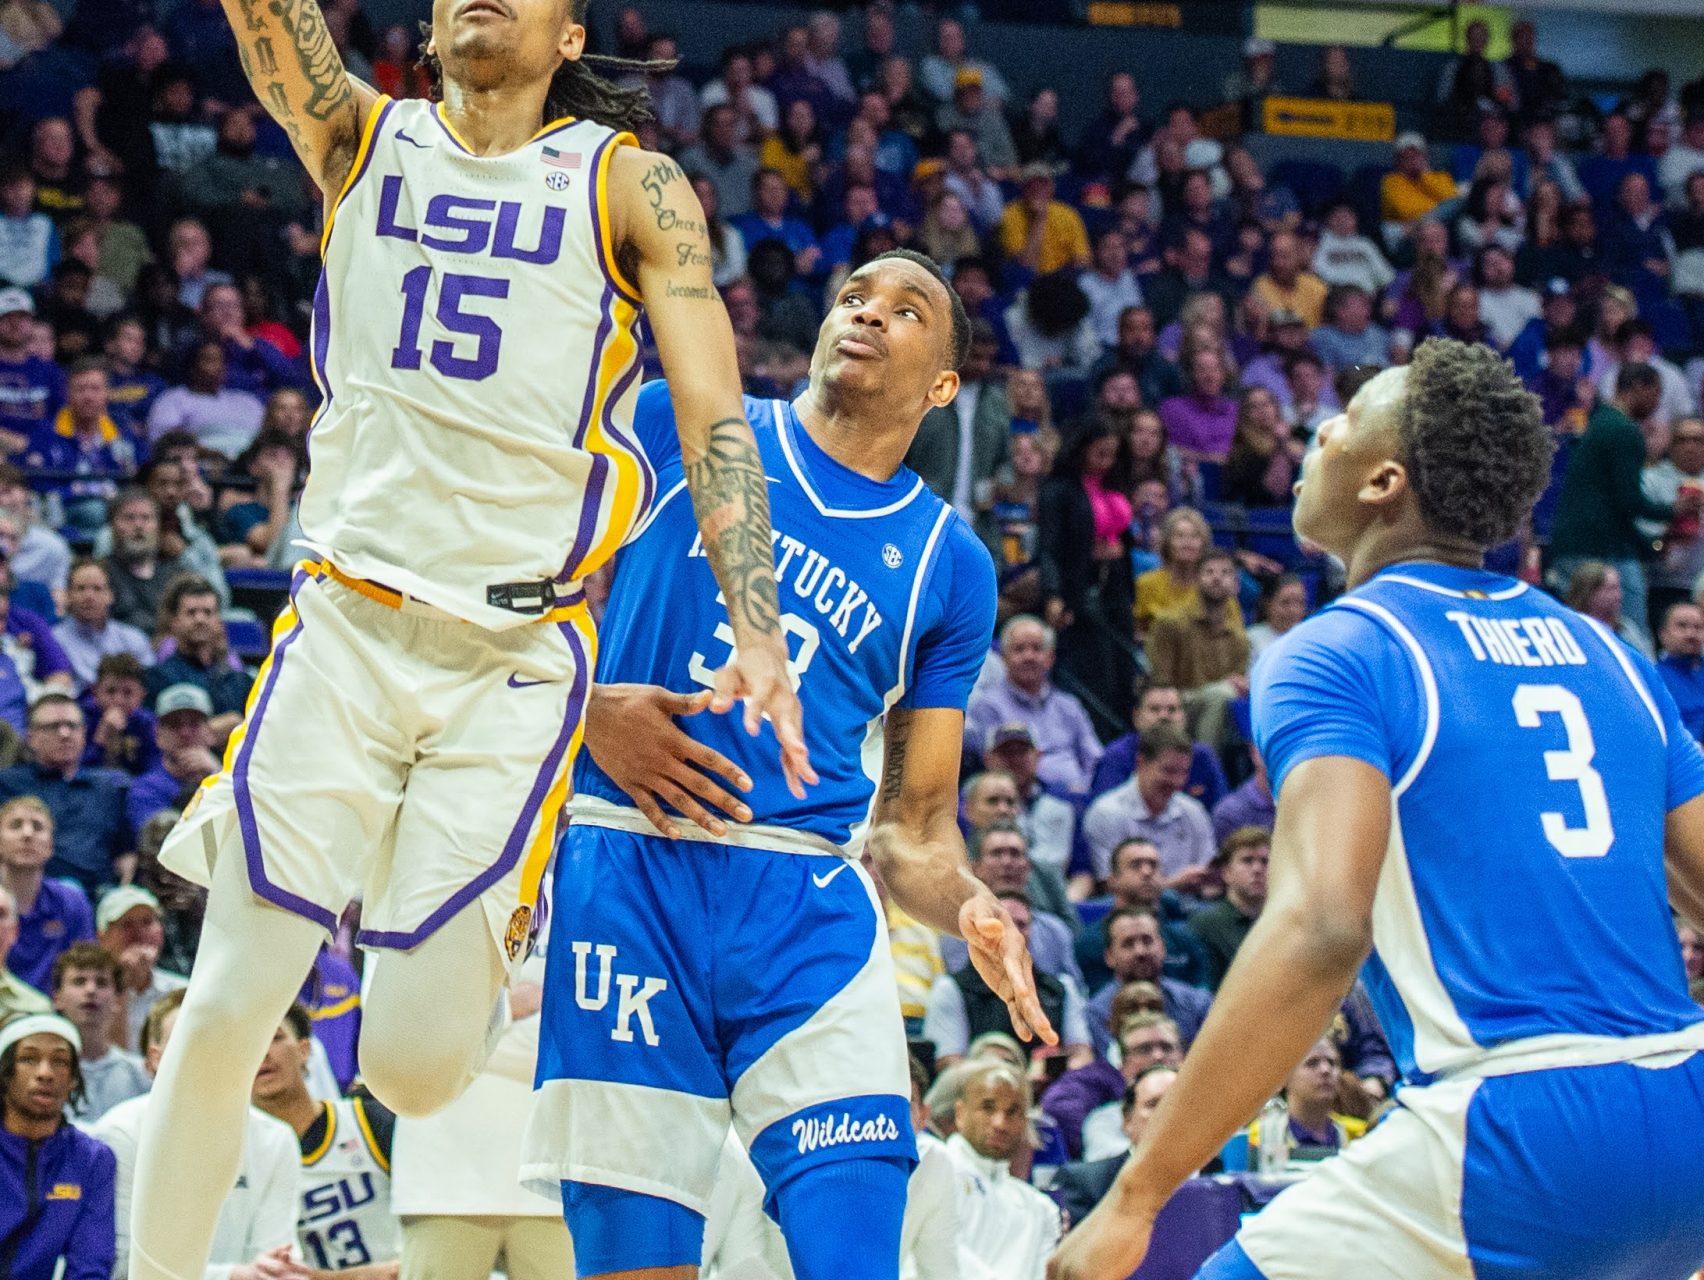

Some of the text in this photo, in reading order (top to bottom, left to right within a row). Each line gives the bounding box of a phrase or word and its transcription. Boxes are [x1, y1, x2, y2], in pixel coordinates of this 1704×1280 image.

[641, 161, 677, 208] 5th
[375, 174, 567, 265] LSU
[391, 265, 510, 382] 15
[1445, 610, 1588, 666] THIERO
[1511, 684, 1616, 858] 3
[571, 941, 667, 1047] UK
[792, 1112, 899, 1154] Wildcats
[298, 1171, 375, 1226] SU
[305, 1219, 371, 1270] 13
